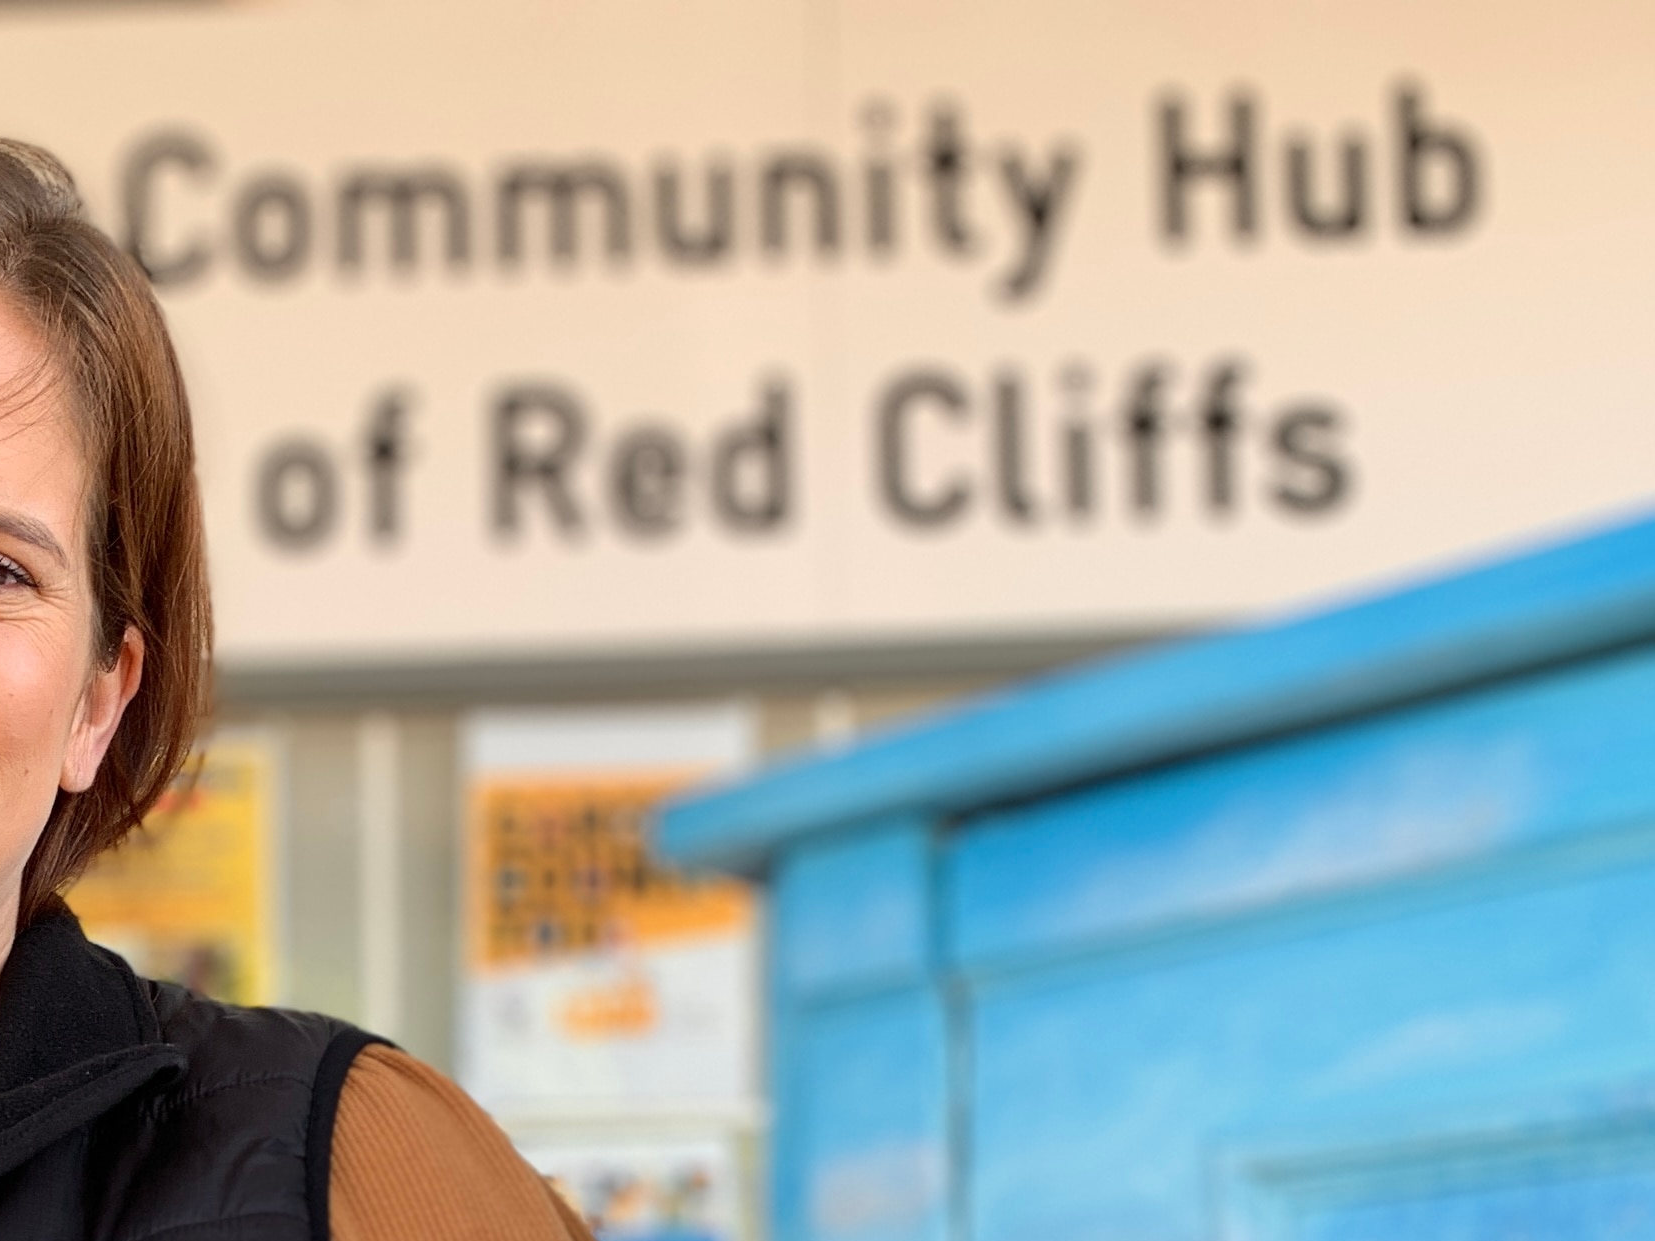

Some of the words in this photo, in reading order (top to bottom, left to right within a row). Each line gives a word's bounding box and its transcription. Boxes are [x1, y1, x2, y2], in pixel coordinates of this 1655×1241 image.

[121, 98, 1083, 304] Community
[1149, 74, 1489, 248] Hub
[252, 382, 419, 556] of
[485, 368, 799, 546] Red
[869, 355, 1358, 533] Cliffs
